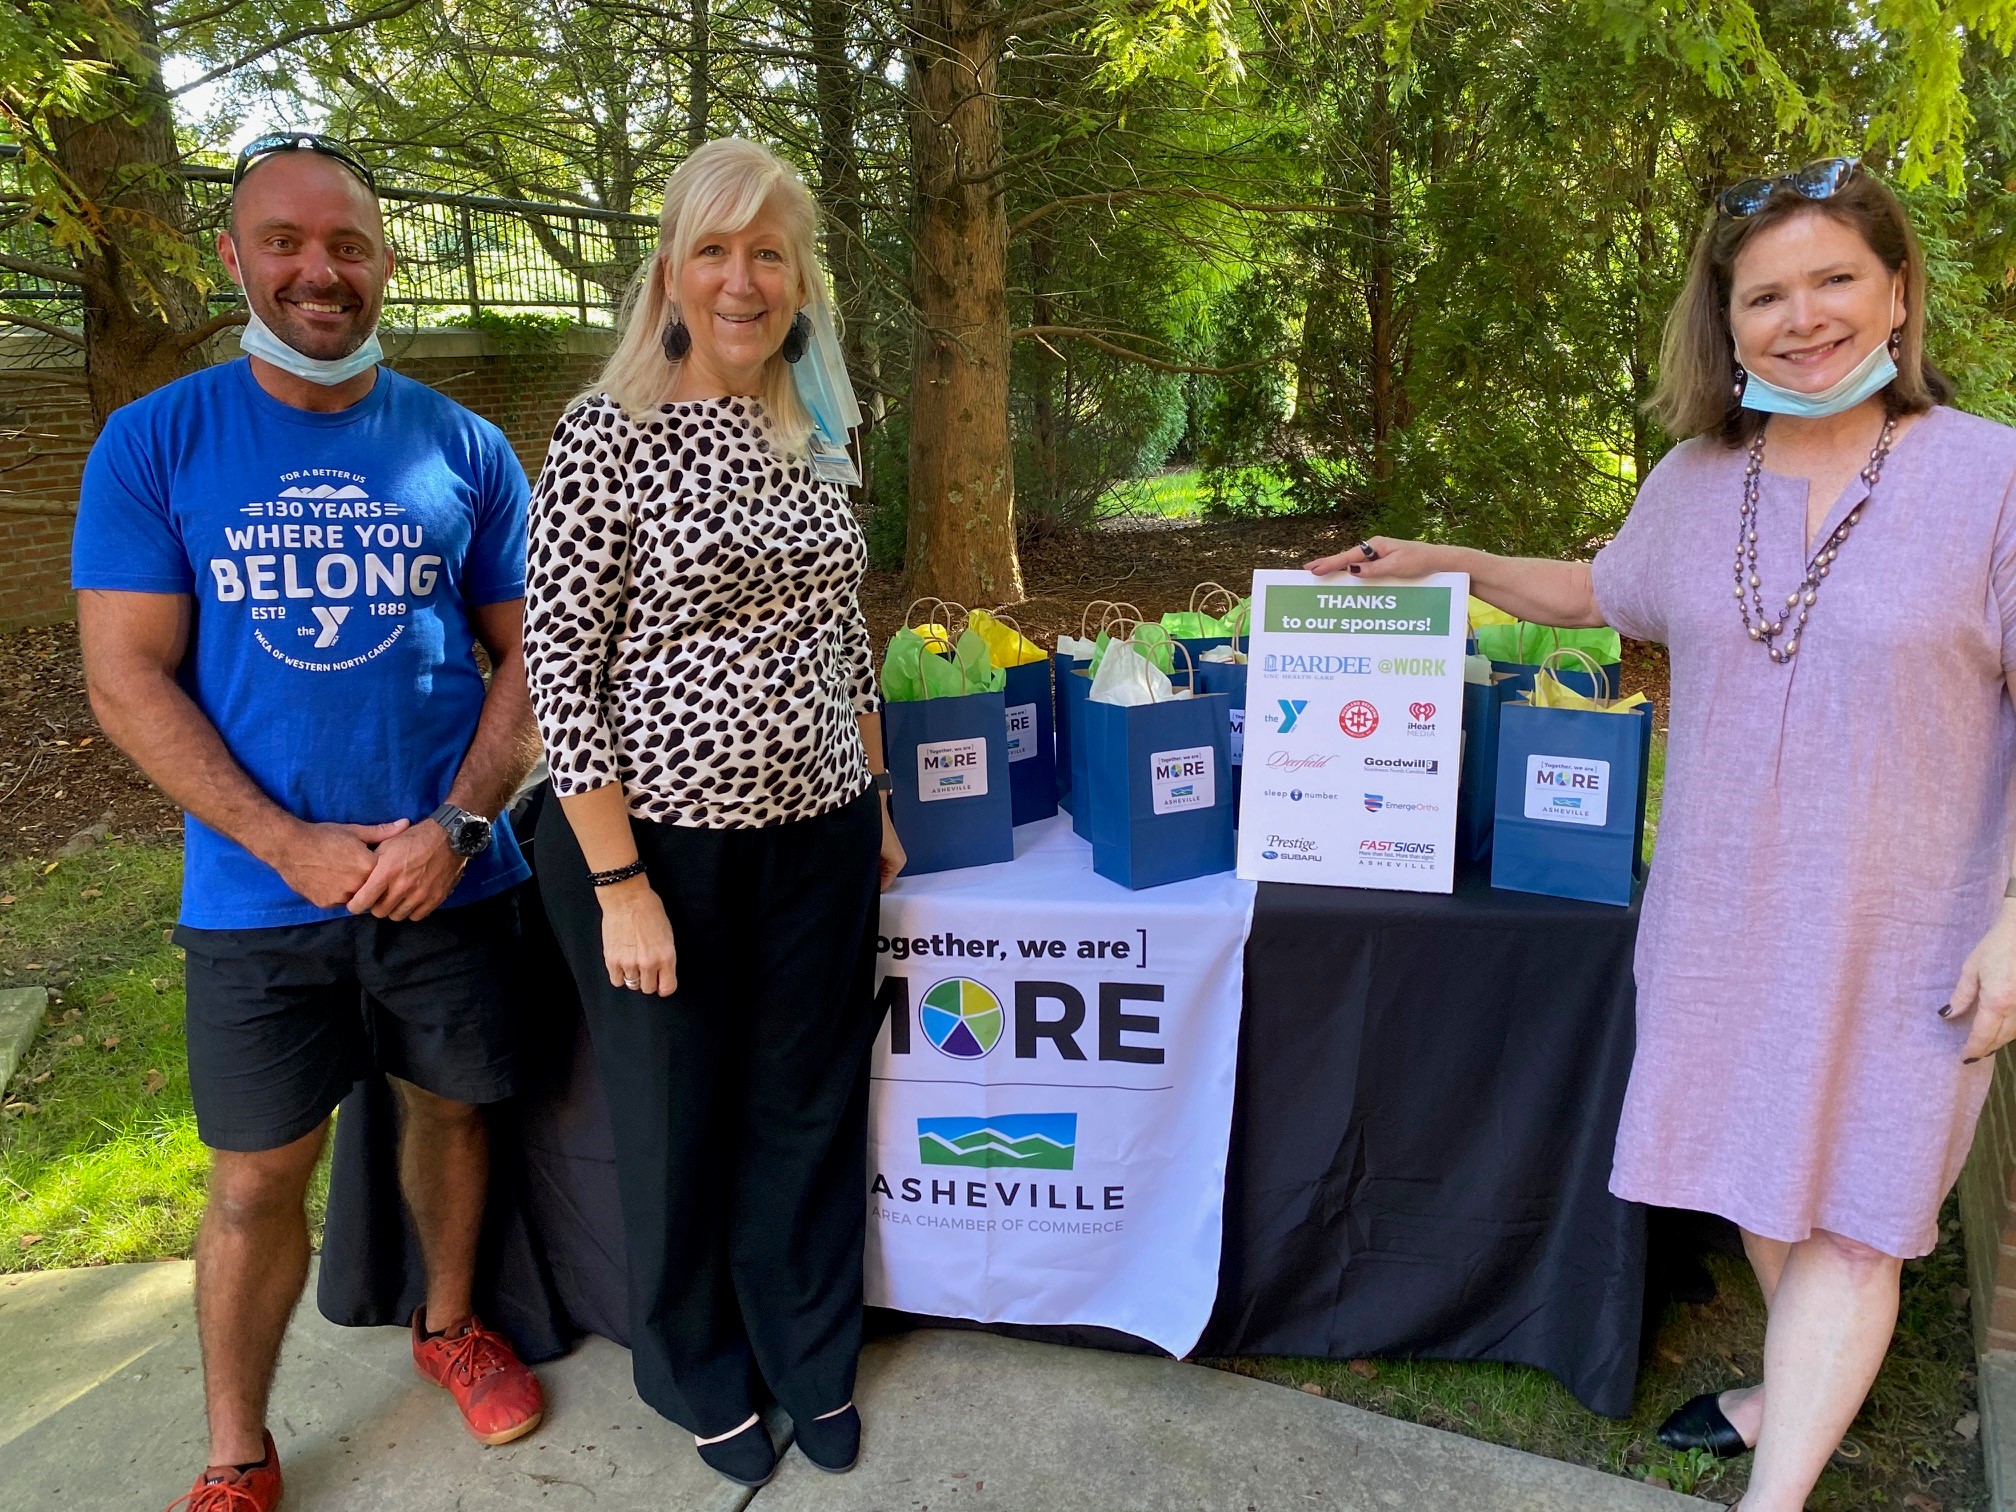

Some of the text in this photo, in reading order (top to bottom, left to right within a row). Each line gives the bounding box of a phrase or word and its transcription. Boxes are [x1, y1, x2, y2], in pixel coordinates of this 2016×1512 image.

[280, 469, 367, 484] FOR A BETTER US
[265, 501, 382, 518] 130 YEARS
[225, 524, 422, 550] WHERE YOU
[210, 553, 442, 602] BELONG
[369, 603, 407, 615] 1889
[1317, 594, 1397, 609] THANKS
[297, 626, 315, 636] the
[1282, 616, 1431, 633] to our sponsors!
[253, 624, 405, 672] YMCA OF WESTERN NORTH CAROLINA
[1280, 654, 1447, 676] PARDEE @WORK
[1264, 714, 1279, 723] the
[1407, 722, 1436, 731] iHeart
[1407, 730, 1436, 738] MEDIA
[924, 752, 977, 770] MORE
[1266, 751, 1339, 773] Deerfield
[1364, 757, 1426, 768] Goodwill
[1156, 761, 1205, 780] MORE
[1536, 770, 1599, 790] MORE
[932, 784, 972, 793] ASHEVILLE
[1264, 789, 1288, 799] sleep
[1164, 796, 1200, 805] ASHEVILLE
[1385, 802, 1439, 811] EmergeOrtho
[1542, 807, 1590, 817] ASHEVILLE
[1266, 835, 1318, 852] Prestige
[1280, 853, 1322, 862] SUBARU
[1359, 860, 1435, 870] ASHEVILLE
[877, 933, 1006, 961] ogether,
[1017, 939, 1066, 958] we
[870, 1173, 1124, 1210] ASHEVILLE
[871, 1206, 1124, 1234] AREA CHAMBER OF COMMERCE
